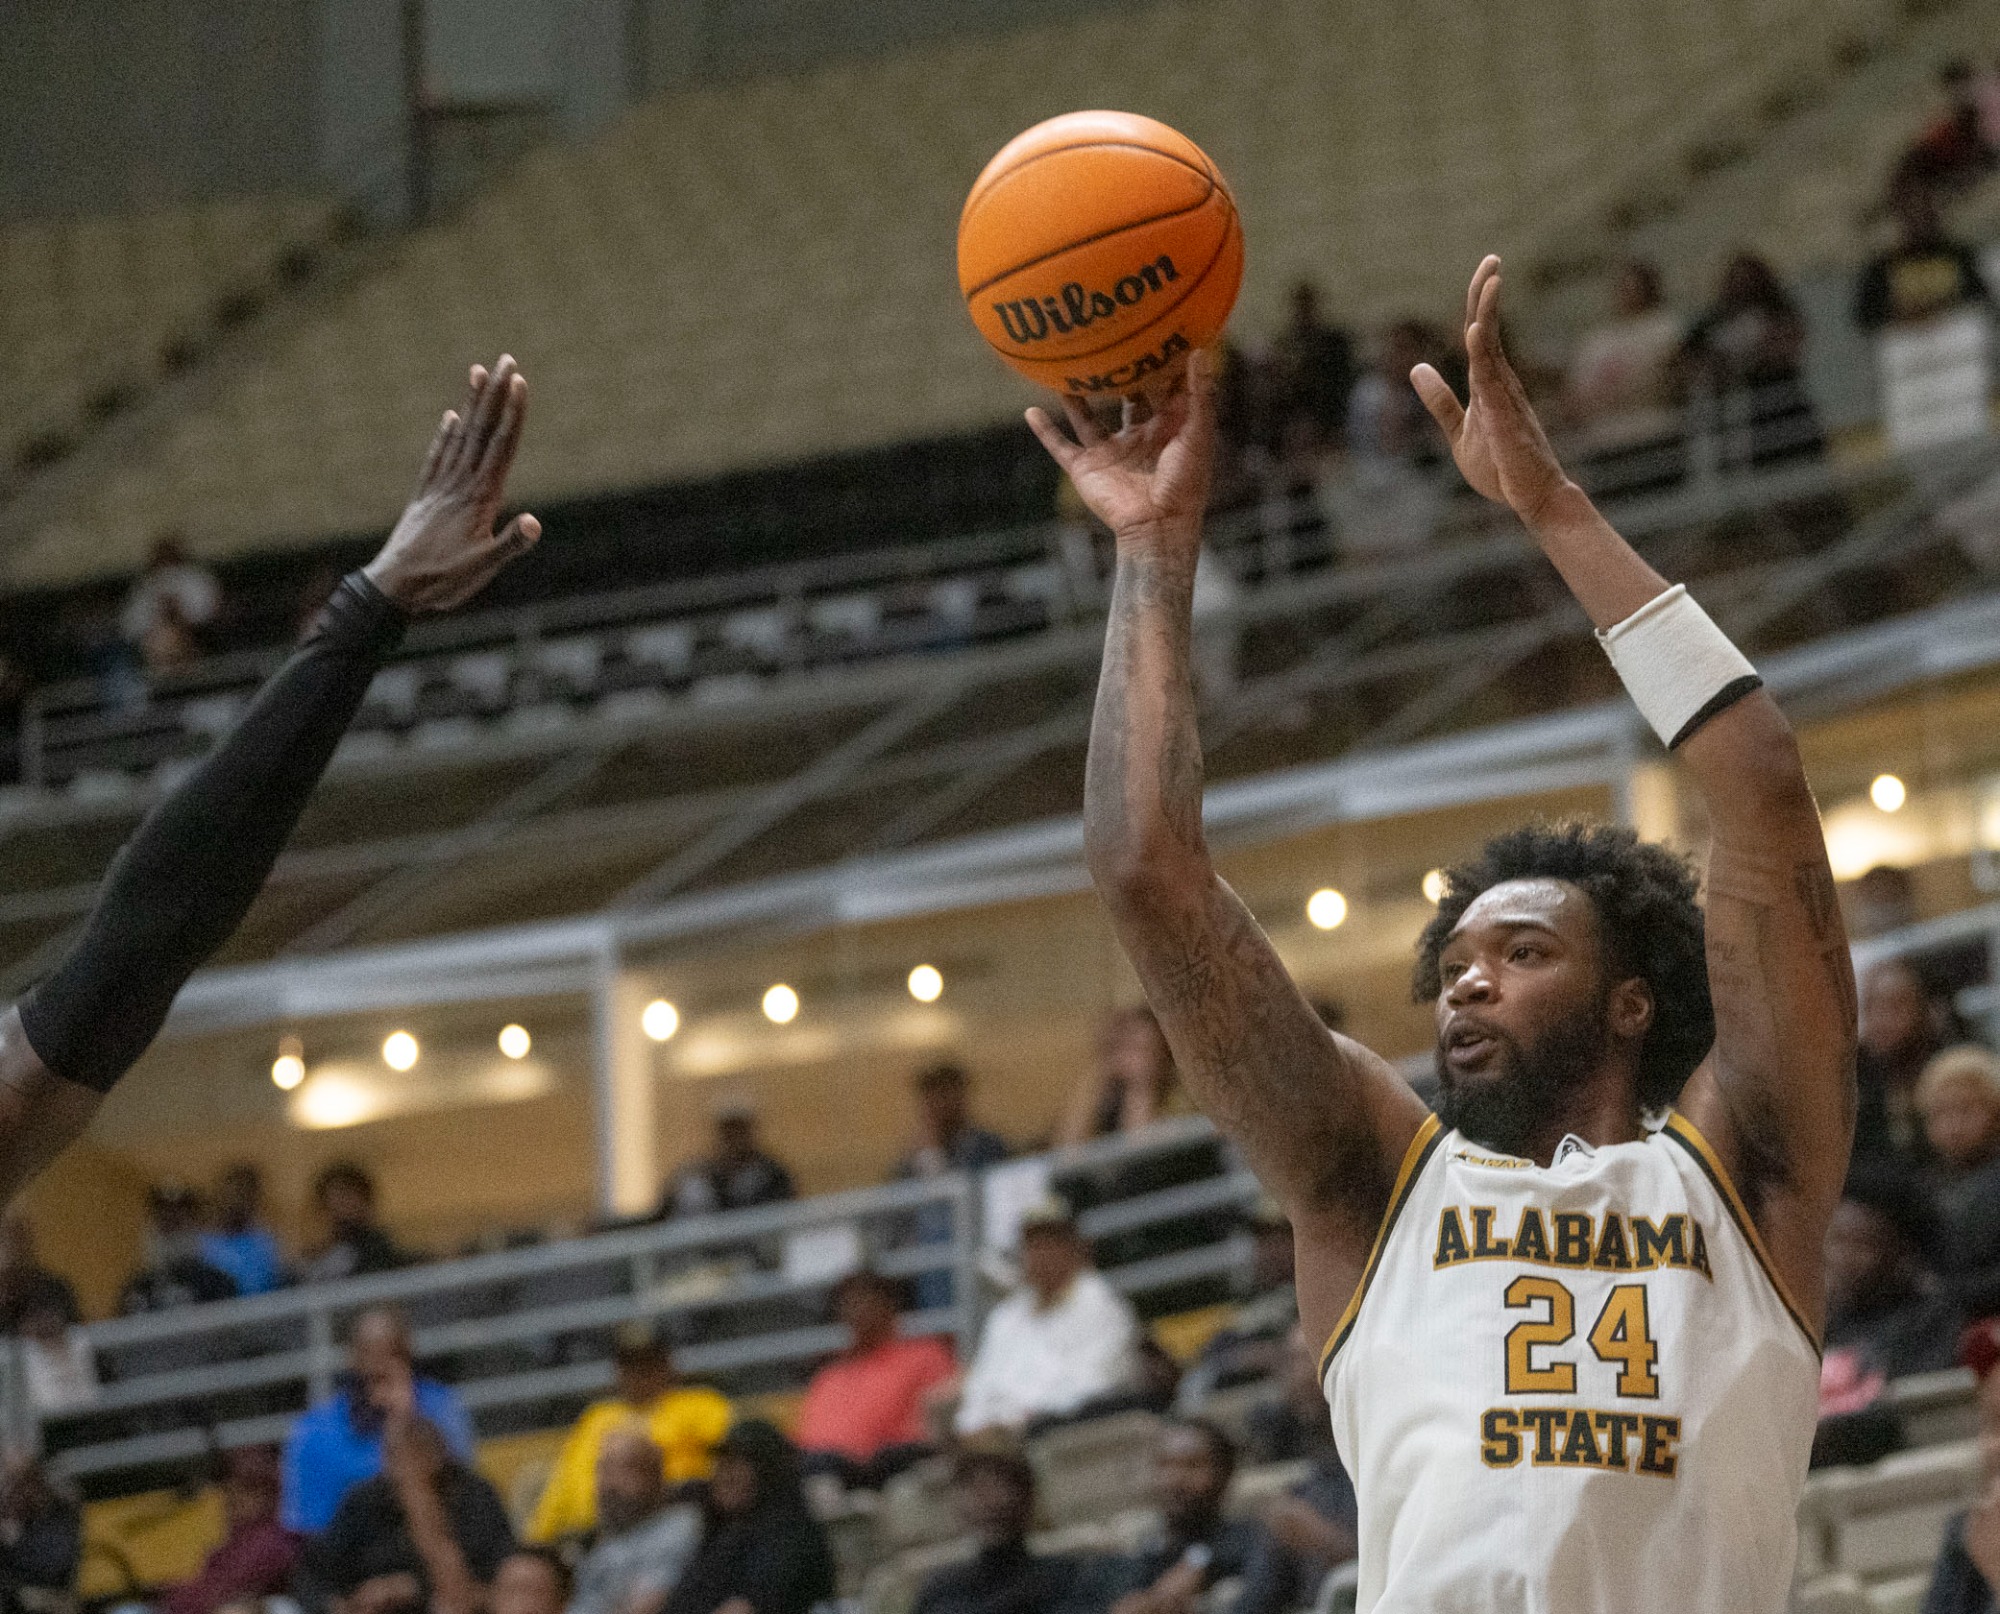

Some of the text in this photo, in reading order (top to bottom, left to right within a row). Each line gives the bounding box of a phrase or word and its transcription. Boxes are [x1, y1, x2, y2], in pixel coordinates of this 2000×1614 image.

[994, 255, 1178, 344] Wilson
[1067, 332, 1189, 391] NCAA
[1434, 1206, 1713, 1283] ALABAMA
[1504, 1275, 1659, 1399] 24
[1481, 1408, 1682, 1478] STATE
